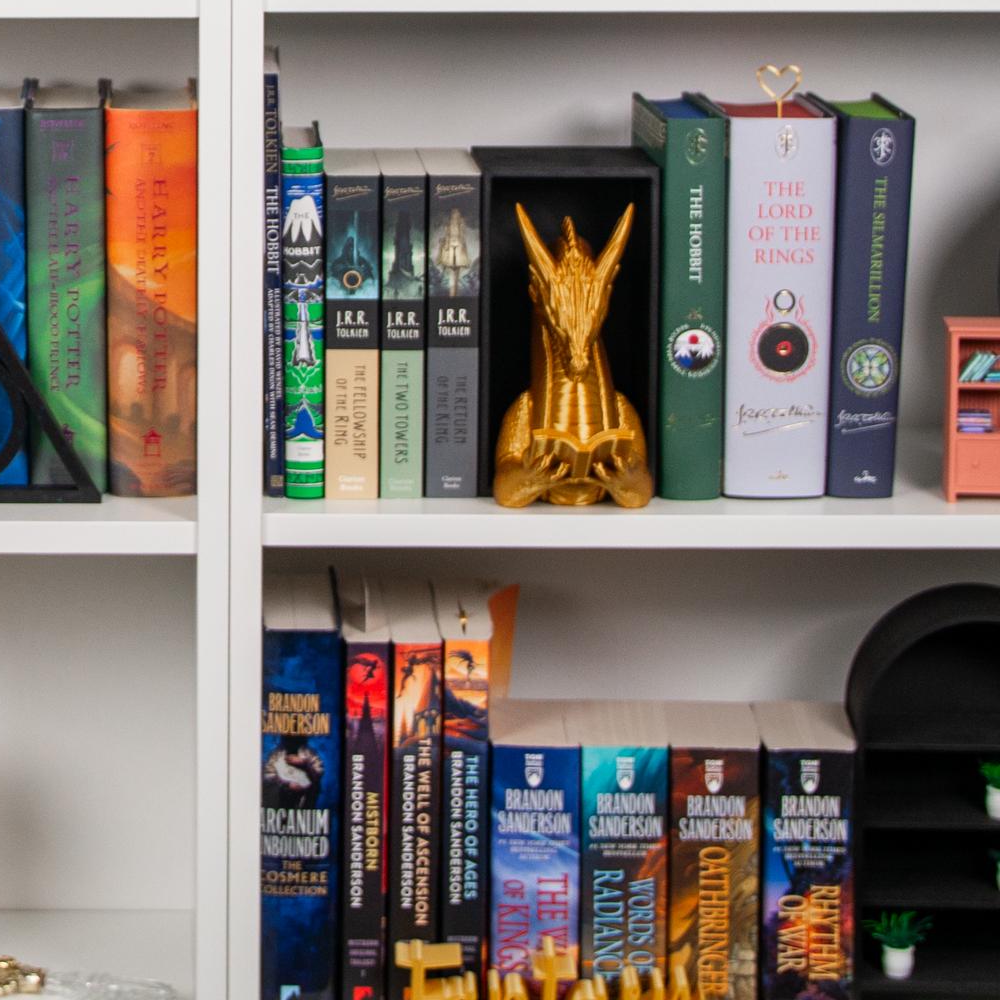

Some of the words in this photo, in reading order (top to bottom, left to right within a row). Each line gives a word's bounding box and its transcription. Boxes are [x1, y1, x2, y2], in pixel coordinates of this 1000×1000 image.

[265, 107, 278, 173] TOLKIEN
[266, 186, 279, 216] THE
[689, 184, 704, 219] THE
[763, 180, 806, 199] THE
[872, 177, 888, 209] THE
[64, 175, 82, 278] HARRY
[757, 202, 813, 220] LORD
[152, 178, 169, 280] HARRY
[748, 225, 776, 243] OF
[779, 225, 822, 243] THE
[266, 218, 280, 275] HOBBIT
[283, 246, 320, 256] HOBBIT
[688, 223, 703, 284] HOBBIT
[755, 247, 815, 265] RINGS
[866, 212, 886, 323] SILMARILLION
[336, 310, 369, 327] J.R.R.
[387, 311, 420, 328] J.R.R.
[438, 308, 471, 325] J.R.R.
[65, 288, 82, 390] POTTER
[151, 292, 169, 393] POTTER
[267, 334, 275, 367] CHARLES
[49, 341, 60, 392] PRINCE
[354, 364, 366, 383] THE
[396, 361, 408, 379] THE
[335, 378, 347, 390] OF
[395, 383, 408, 411] TWO
[455, 375, 468, 394] THE
[268, 391, 276, 413] WITH
[336, 393, 347, 411] THE
[268, 413, 276, 431] SEAN
[334, 415, 348, 446] RING
[353, 385, 367, 460] FELLOWSHIP
[435, 413, 449, 445] KING
[453, 396, 469, 445] RETURN
[394, 415, 408, 465] TOWERS
[268, 692, 320, 712] BRANDON
[417, 738, 433, 767] THE
[450, 750, 463, 818] BRANDON
[465, 755, 479, 785] THE
[351, 754, 364, 821] BRANDON
[402, 754, 416, 821] BRANDON
[416, 770, 432, 809] WELL
[505, 788, 564, 811] BRANDON
[465, 788, 479, 832] HERO
[596, 792, 655, 815] BRANDON
[687, 795, 746, 818] BRANDON
[781, 795, 840, 818] BRANDON
[365, 791, 380, 871] MISTBORN
[416, 812, 431, 834] OF
[498, 811, 572, 834] SANDERSON
[588, 815, 663, 839] SANDERSON
[679, 818, 753, 841] SANDERSON
[773, 818, 849, 841] SANDERSON
[464, 835, 478, 857] OF
[350, 825, 363, 908] SANDERSON
[401, 825, 415, 908] SANDERSON
[449, 821, 462, 905] SANDERSON
[415, 837, 431, 926] ASCENSION
[463, 859, 478, 900] AGES
[503, 878, 525, 900] OF
[537, 872, 569, 921] THE
[628, 877, 655, 946] WORDS
[777, 894, 808, 920] OF
[699, 846, 730, 996] OATHBRINGER
[808, 884, 841, 981] RHYTHM
[497, 903, 531, 971] KINGS
[776, 924, 808, 975] WAR
